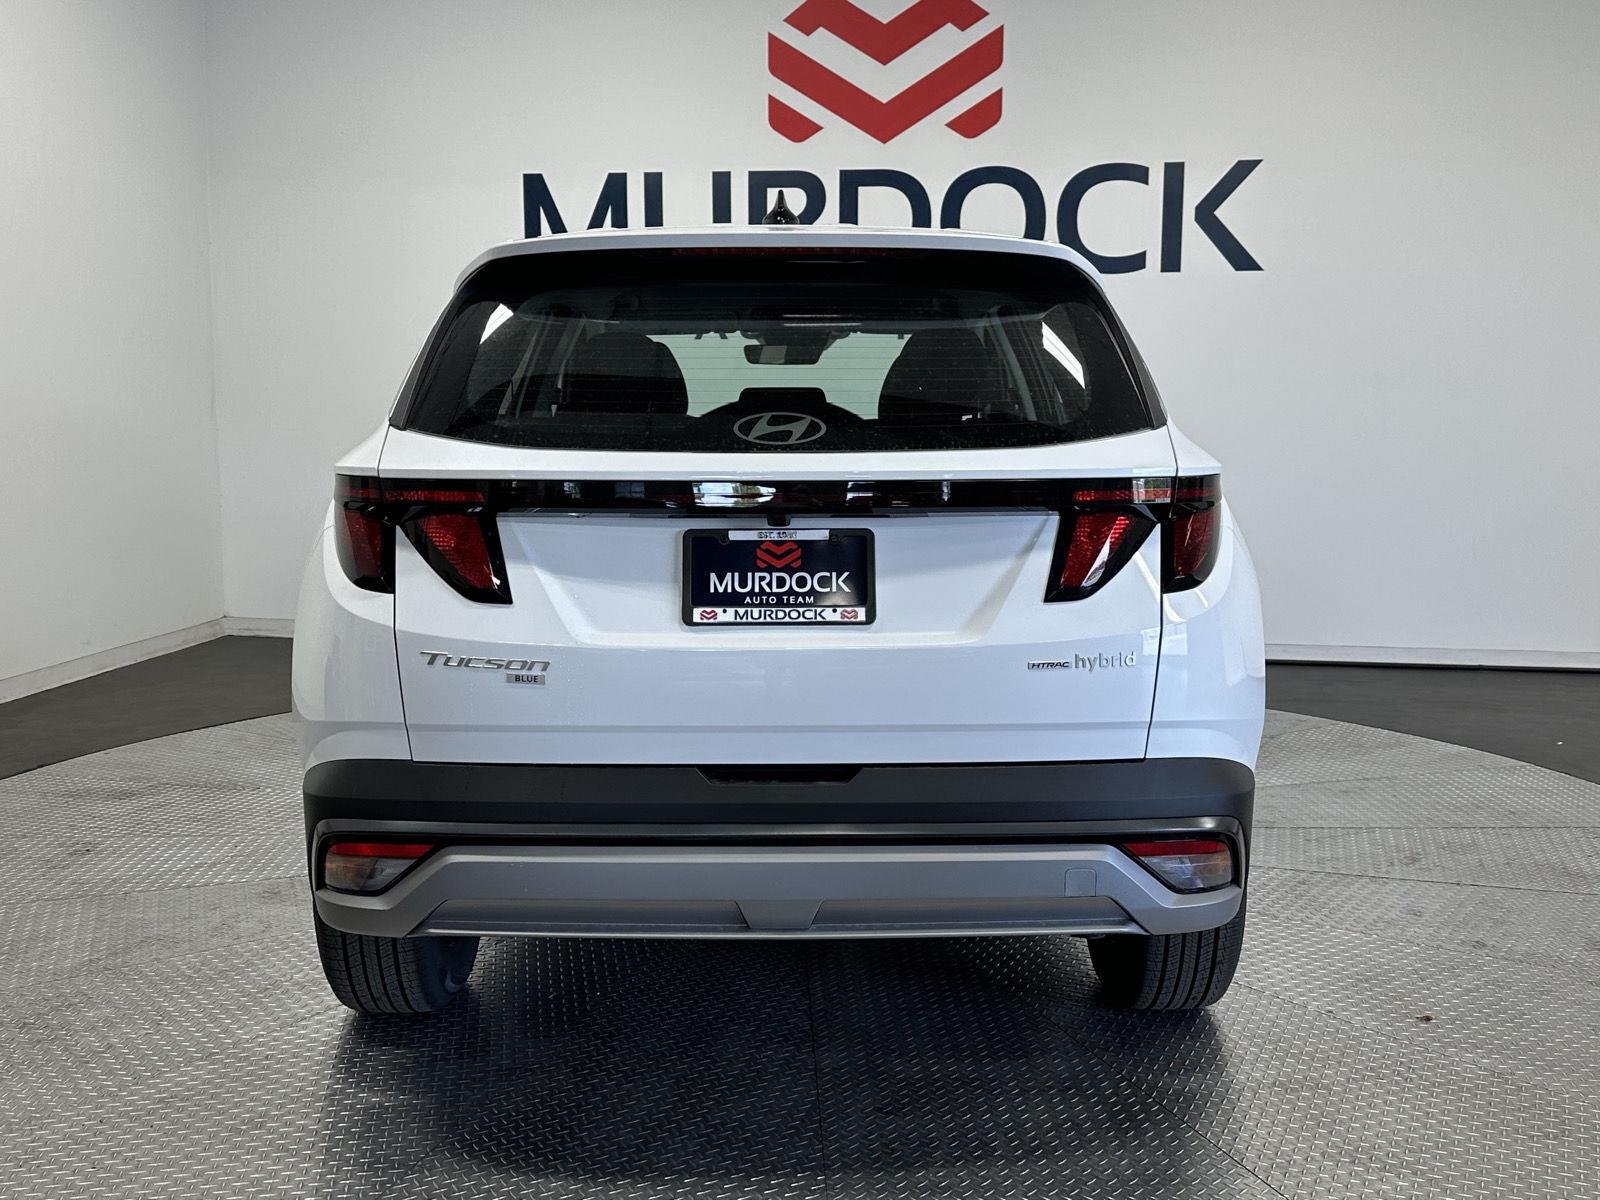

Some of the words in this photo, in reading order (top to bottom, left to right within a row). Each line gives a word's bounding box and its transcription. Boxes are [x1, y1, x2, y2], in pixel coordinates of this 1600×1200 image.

[709, 571, 851, 593] MURDOCK
[744, 596, 777, 604] AUTO
[782, 596, 814, 604] TEAM
[734, 608, 827, 620] MURDOCK
[1031, 661, 1070, 669] HTRAC
[1074, 651, 1137, 672] hybrid
[514, 674, 539, 683] BLUE
